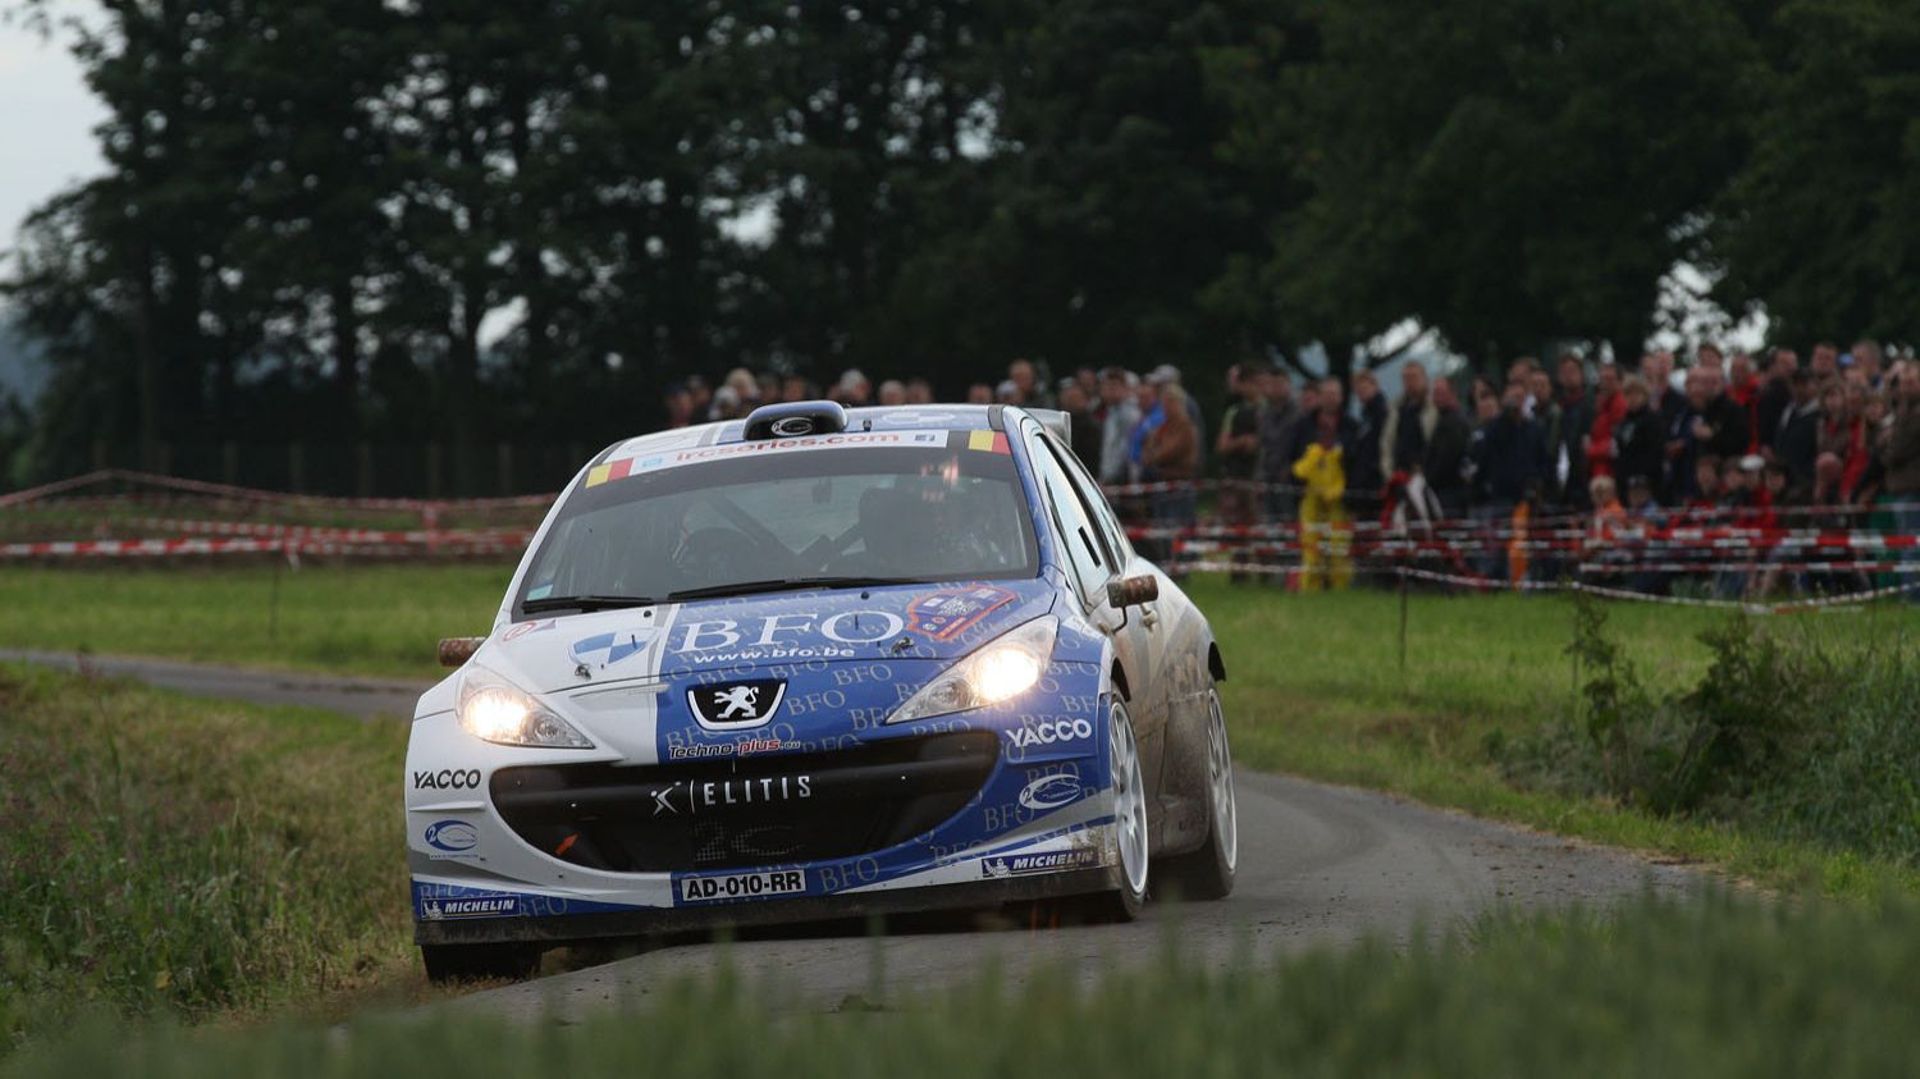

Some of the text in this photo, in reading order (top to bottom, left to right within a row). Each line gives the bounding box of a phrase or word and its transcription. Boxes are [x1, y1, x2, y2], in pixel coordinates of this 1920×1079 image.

[672, 610, 904, 654] BFO
[694, 645, 855, 664] www.bfo.be
[833, 663, 892, 686] BFO
[787, 689, 846, 717] BFO
[1005, 718, 1092, 748] YACCO
[413, 769, 482, 789] YACCO
[703, 775, 811, 806] ELITIS
[1012, 850, 1094, 870] MICHELIN
[686, 871, 802, 899] AD-010-RR
[818, 856, 880, 894] BFO
[444, 899, 515, 914] MICHELIN
